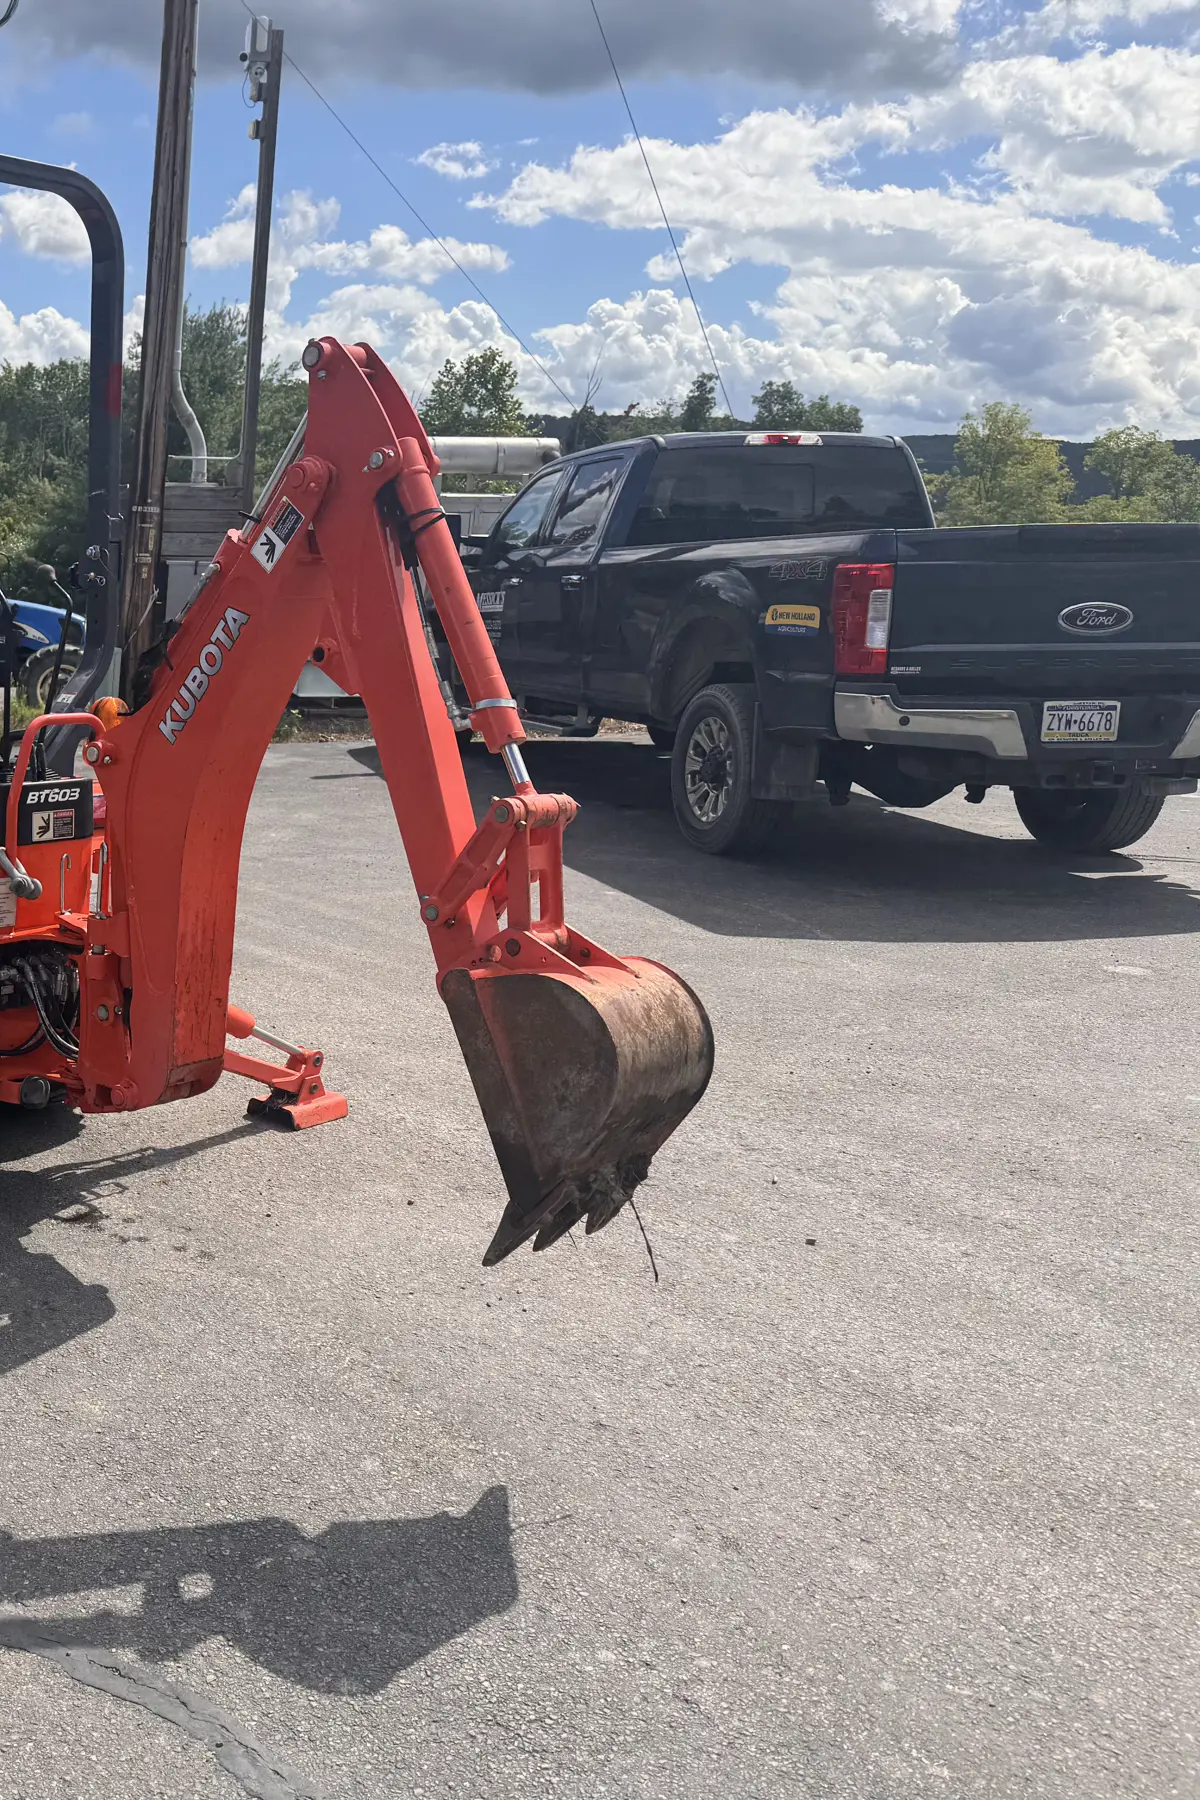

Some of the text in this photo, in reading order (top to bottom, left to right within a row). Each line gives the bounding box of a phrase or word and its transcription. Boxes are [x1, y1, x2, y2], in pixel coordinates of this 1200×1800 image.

[778, 611, 816, 621] NEW HOLLAND
[1076, 607, 1118, 626] Ford
[1115, 656, 1200, 669] DUT
[158, 606, 250, 745] KUBOTA
[26, 788, 81, 804] BT603
